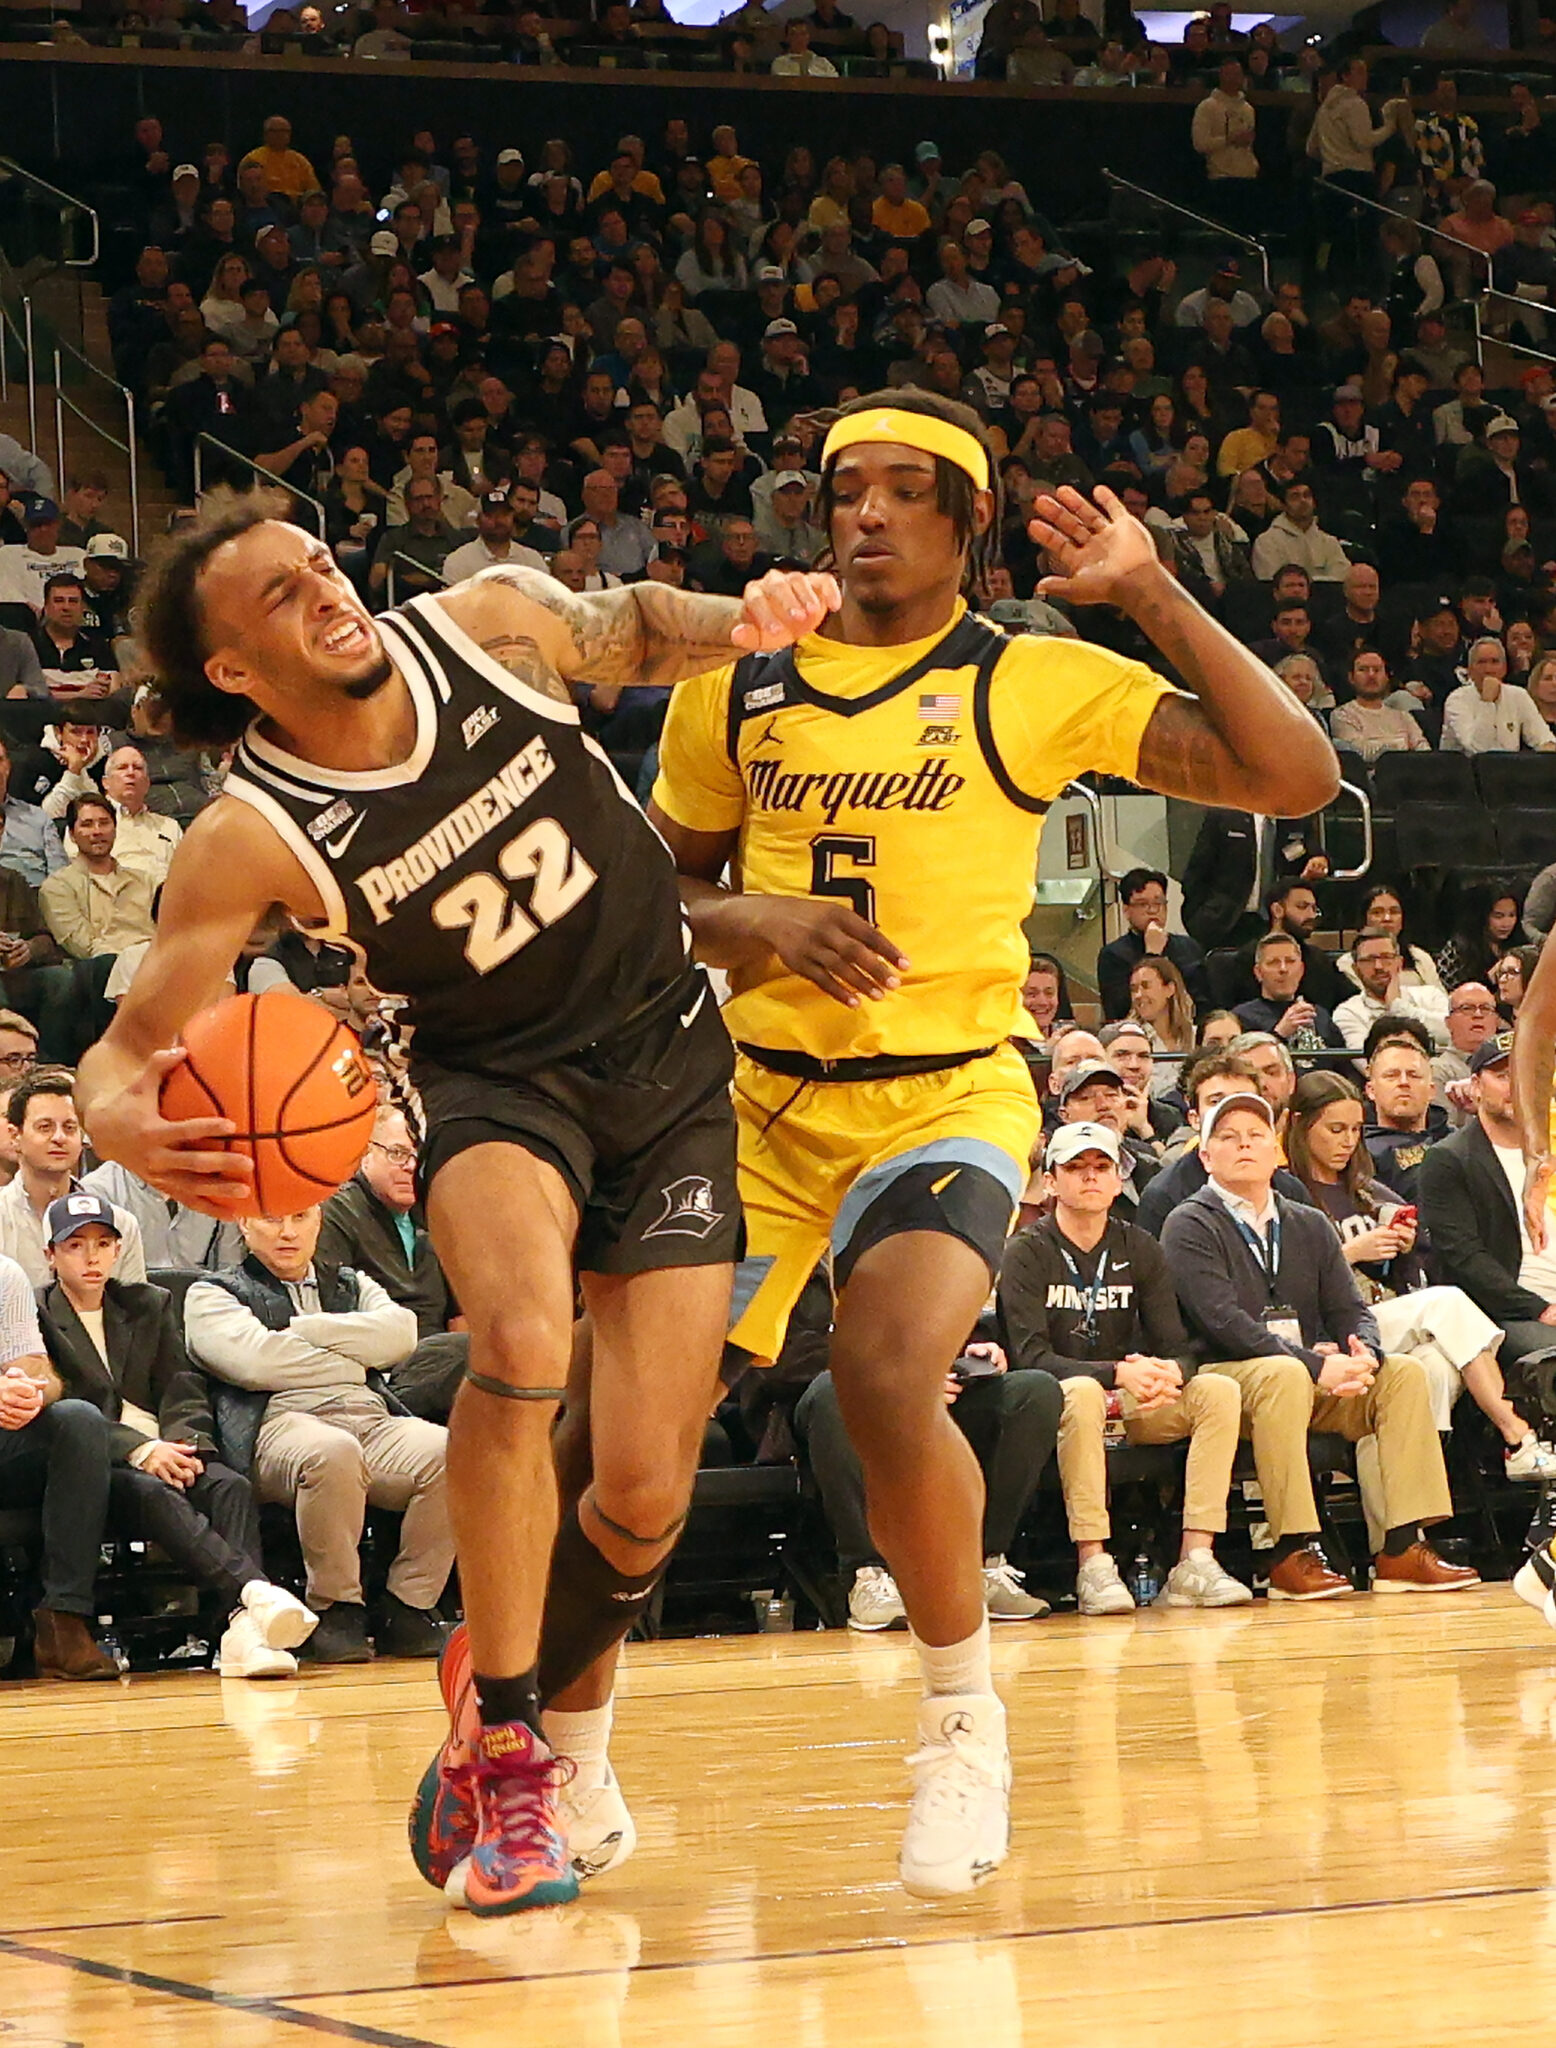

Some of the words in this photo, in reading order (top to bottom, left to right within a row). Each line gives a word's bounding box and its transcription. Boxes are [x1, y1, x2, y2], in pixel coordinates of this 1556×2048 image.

[353, 734, 557, 926] PROVIDENCE
[745, 758, 966, 825] Marquette
[430, 816, 599, 977] 22
[809, 833, 878, 929] 5
